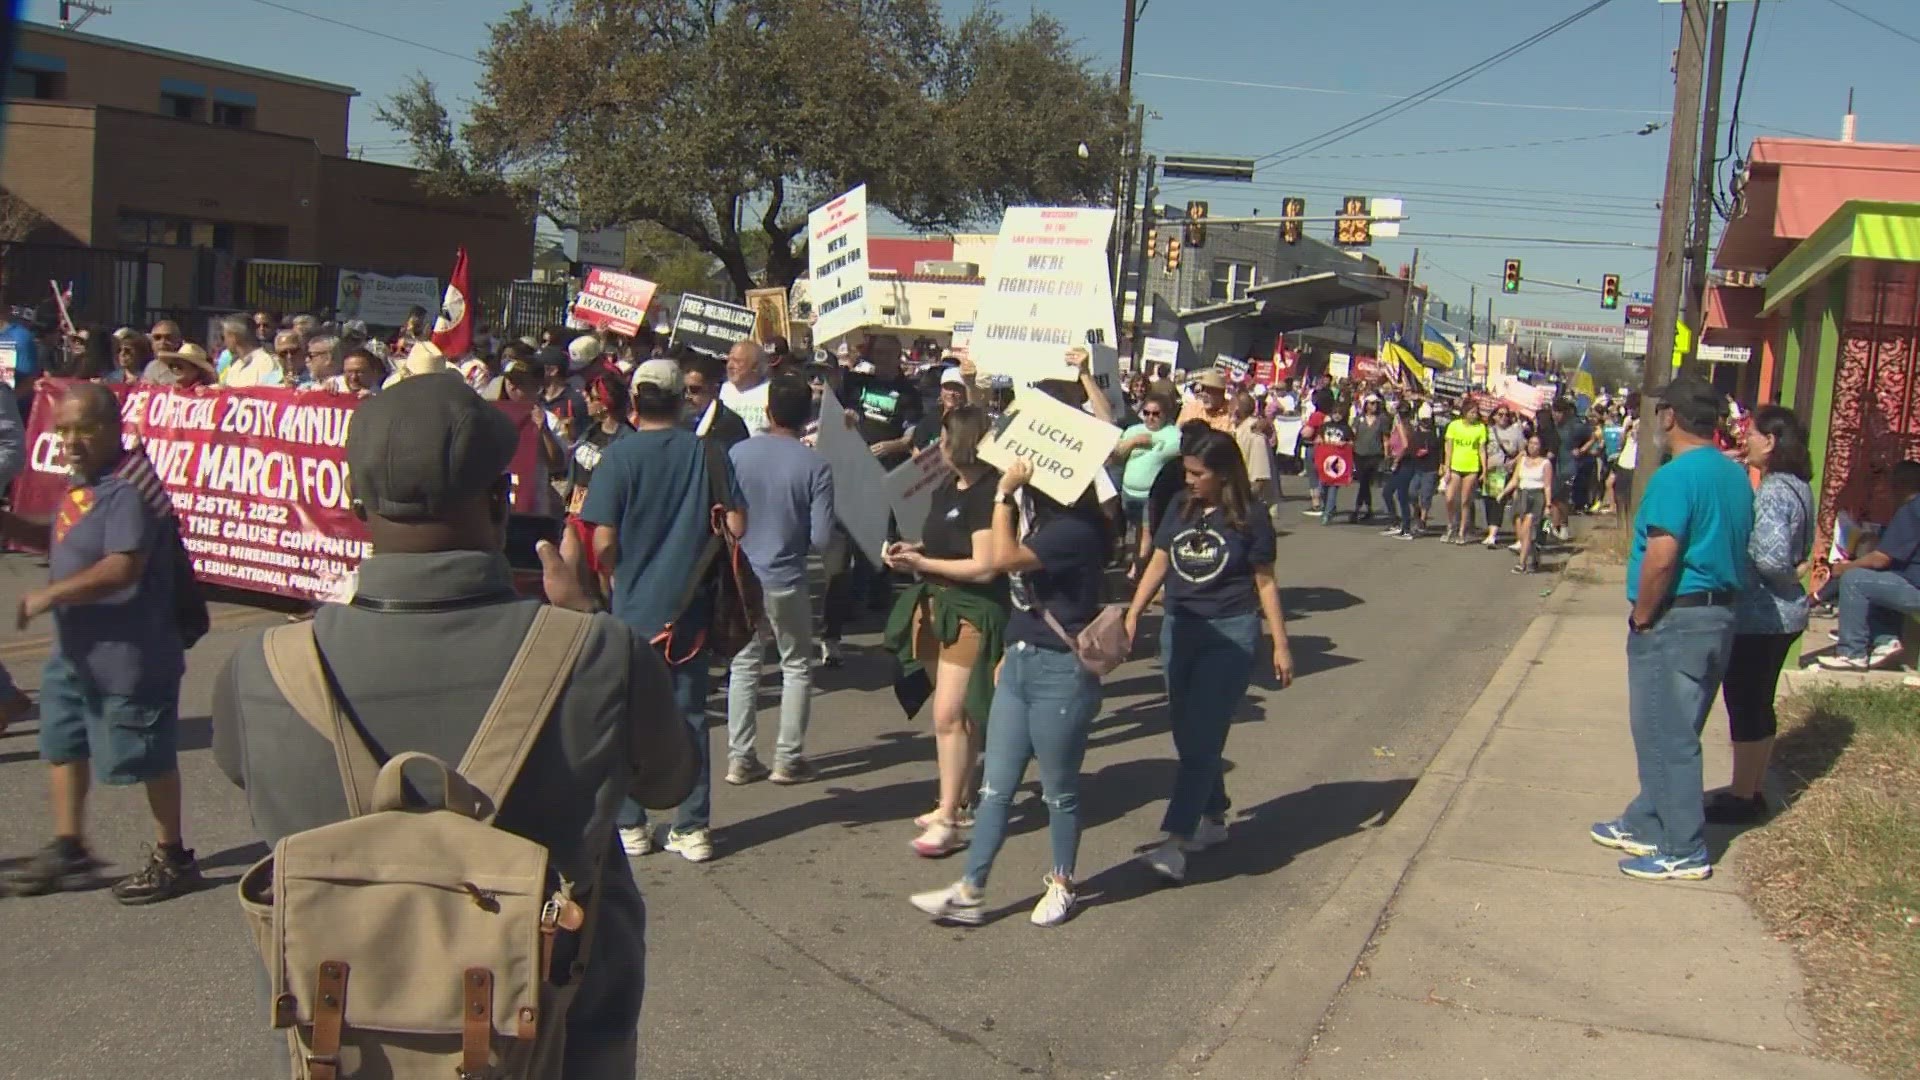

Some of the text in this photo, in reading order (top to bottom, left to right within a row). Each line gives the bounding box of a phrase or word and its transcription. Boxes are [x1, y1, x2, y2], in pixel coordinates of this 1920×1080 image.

[816, 247, 861, 280] FIGHTING FOR
[1027, 254, 1065, 270] WE'RE
[998, 276, 1084, 296] FIGHTING FOR
[583, 296, 639, 319] WRONG?
[817, 295, 840, 317] LIVING
[986, 323, 1028, 342] LIVING
[221, 396, 278, 438] 26TH
[278, 404, 354, 448] ANNU
[1028, 419, 1084, 453] LUCHA
[194, 443, 299, 502] MARCH
[1005, 439, 1074, 480] FUTURO
[248, 501, 289, 525] 2022
[187, 515, 375, 559] THE CAUSE CONTINUE
[204, 559, 289, 587] EDUCATIONAL
